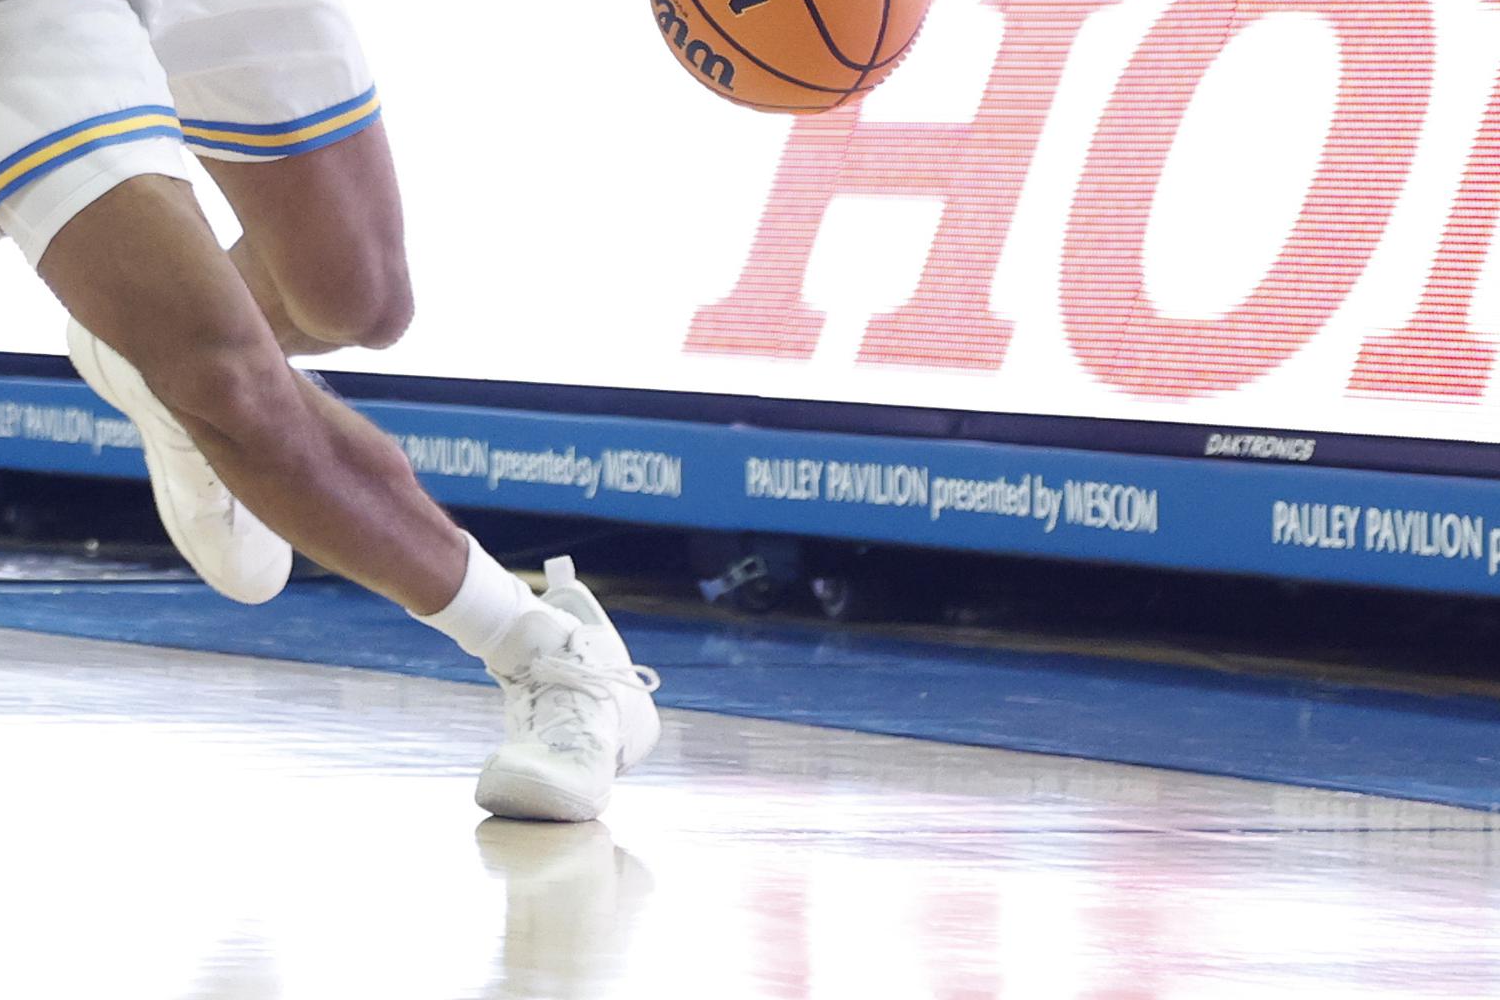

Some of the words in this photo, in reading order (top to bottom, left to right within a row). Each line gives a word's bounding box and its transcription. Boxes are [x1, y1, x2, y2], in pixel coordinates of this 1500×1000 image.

[405, 434, 489, 476] PAVILION
[488, 446, 576, 490] presented
[601, 449, 683, 498] WESCOM
[1204, 433, 1316, 461] DAKTRONICS
[745, 457, 824, 500] PAULEY
[825, 460, 928, 507] PAVILION
[930, 474, 1032, 520] presented
[1033, 475, 1062, 533] by
[1064, 479, 1159, 534] WESCOM
[1271, 500, 1361, 549] PAULEY
[1364, 507, 1484, 560] PAVILION
